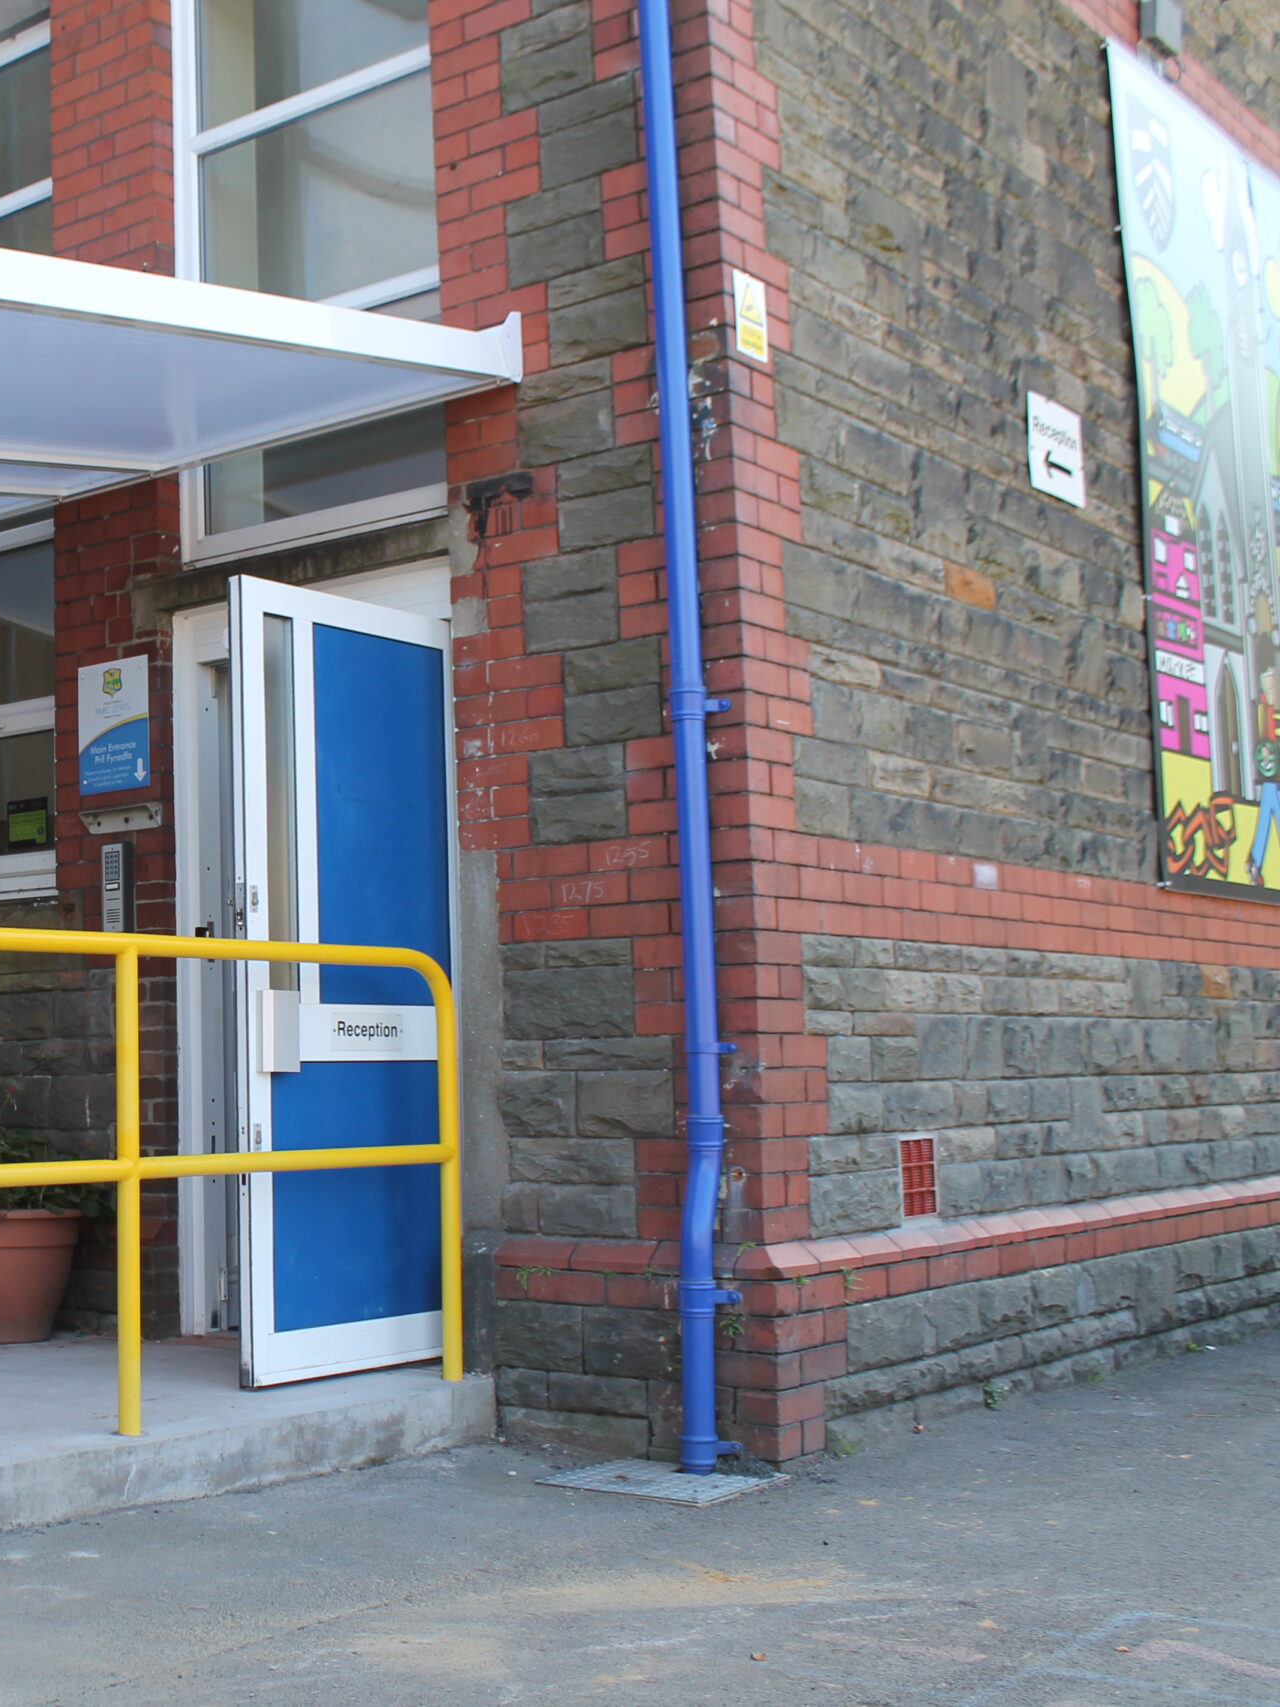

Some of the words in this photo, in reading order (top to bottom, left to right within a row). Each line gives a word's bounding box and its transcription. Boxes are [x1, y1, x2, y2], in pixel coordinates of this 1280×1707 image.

[1032, 415, 1077, 451] Reception
[90, 746, 107, 755] Main
[108, 742, 136, 753] Entrance
[95, 755, 105, 765] Prif
[106, 753, 132, 765] Fynedfa
[337, 1020, 398, 1041] Reception
